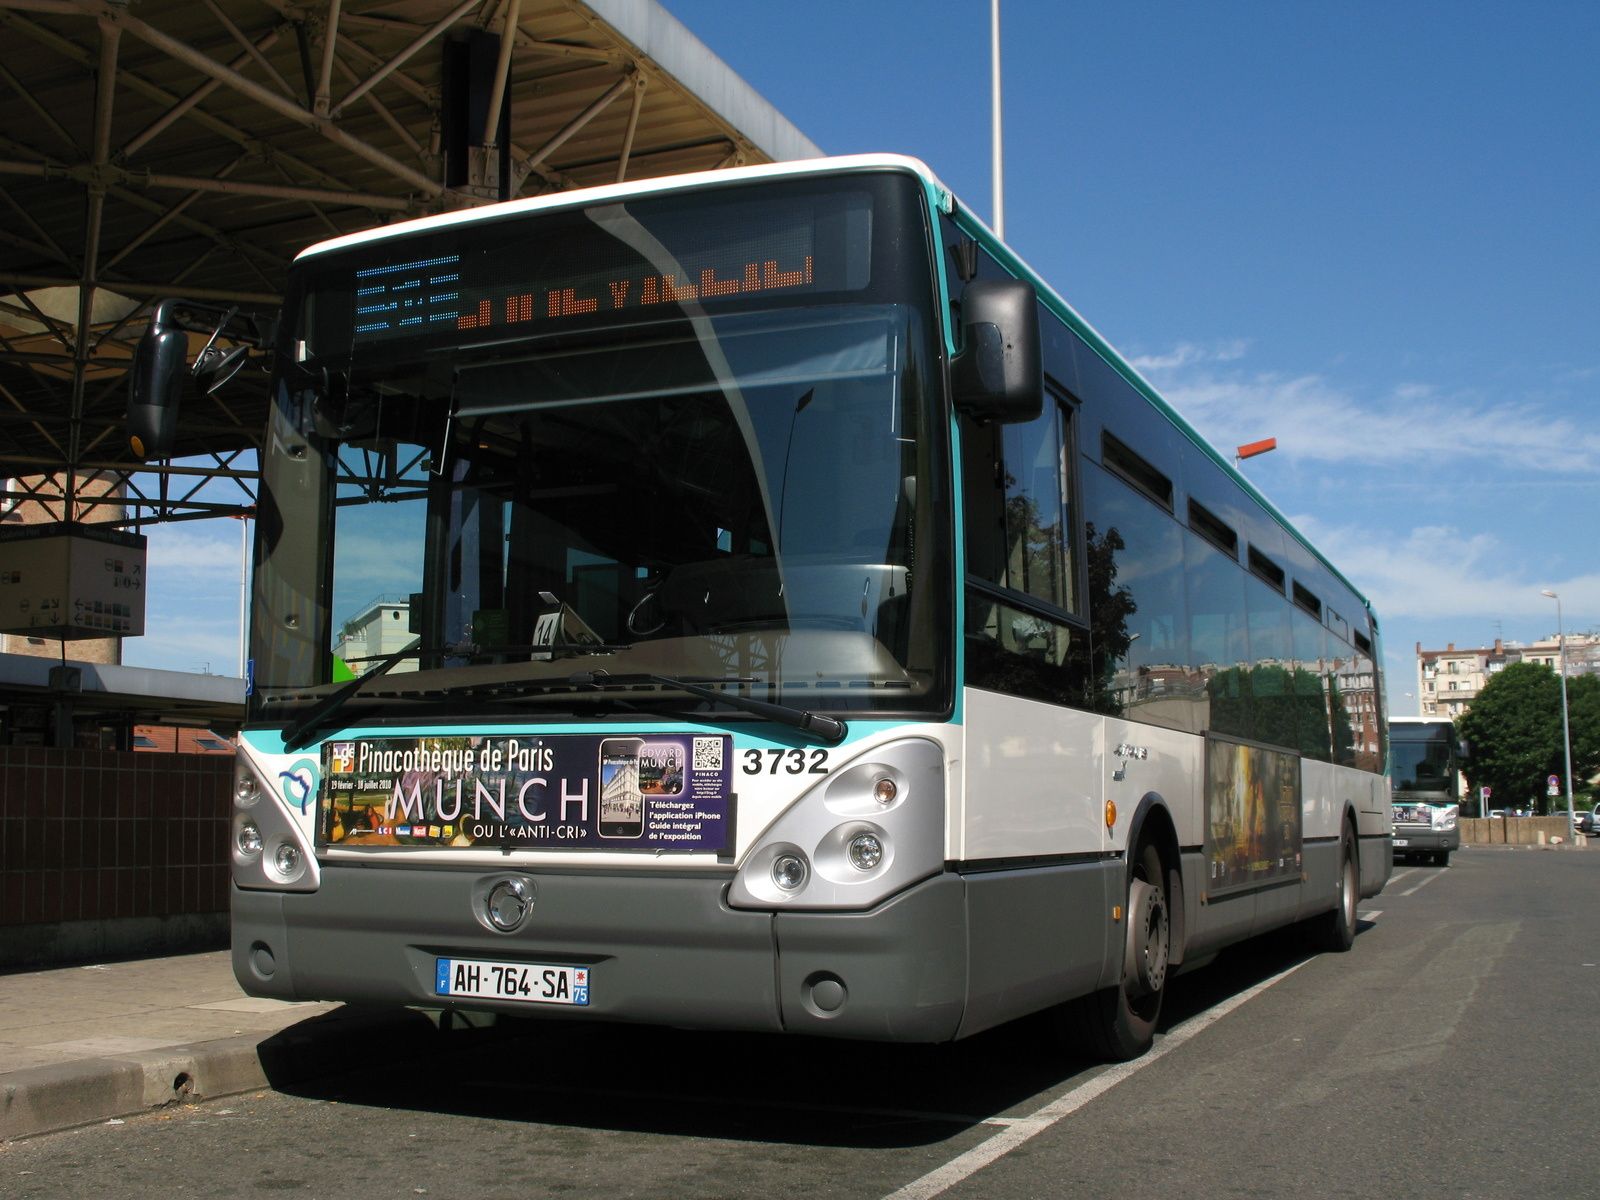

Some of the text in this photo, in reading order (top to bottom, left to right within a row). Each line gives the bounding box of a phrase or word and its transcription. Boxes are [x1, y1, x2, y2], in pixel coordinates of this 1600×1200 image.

[538, 619, 553, 645] 14
[641, 748, 682, 758] EDVARD
[359, 739, 554, 780] Pinacothèque de Paris
[641, 758, 682, 768] MUNCH
[742, 748, 829, 776] 3732
[389, 777, 589, 822] MUNCH
[650, 801, 695, 811] Téléchargez
[649, 811, 721, 821] l'application iPhone
[473, 824, 496, 838] OU
[649, 821, 702, 832] Guide intégral
[648, 832, 702, 842] de l'exposition
[440, 980, 446, 988] F
[574, 987, 587, 1002] 75
